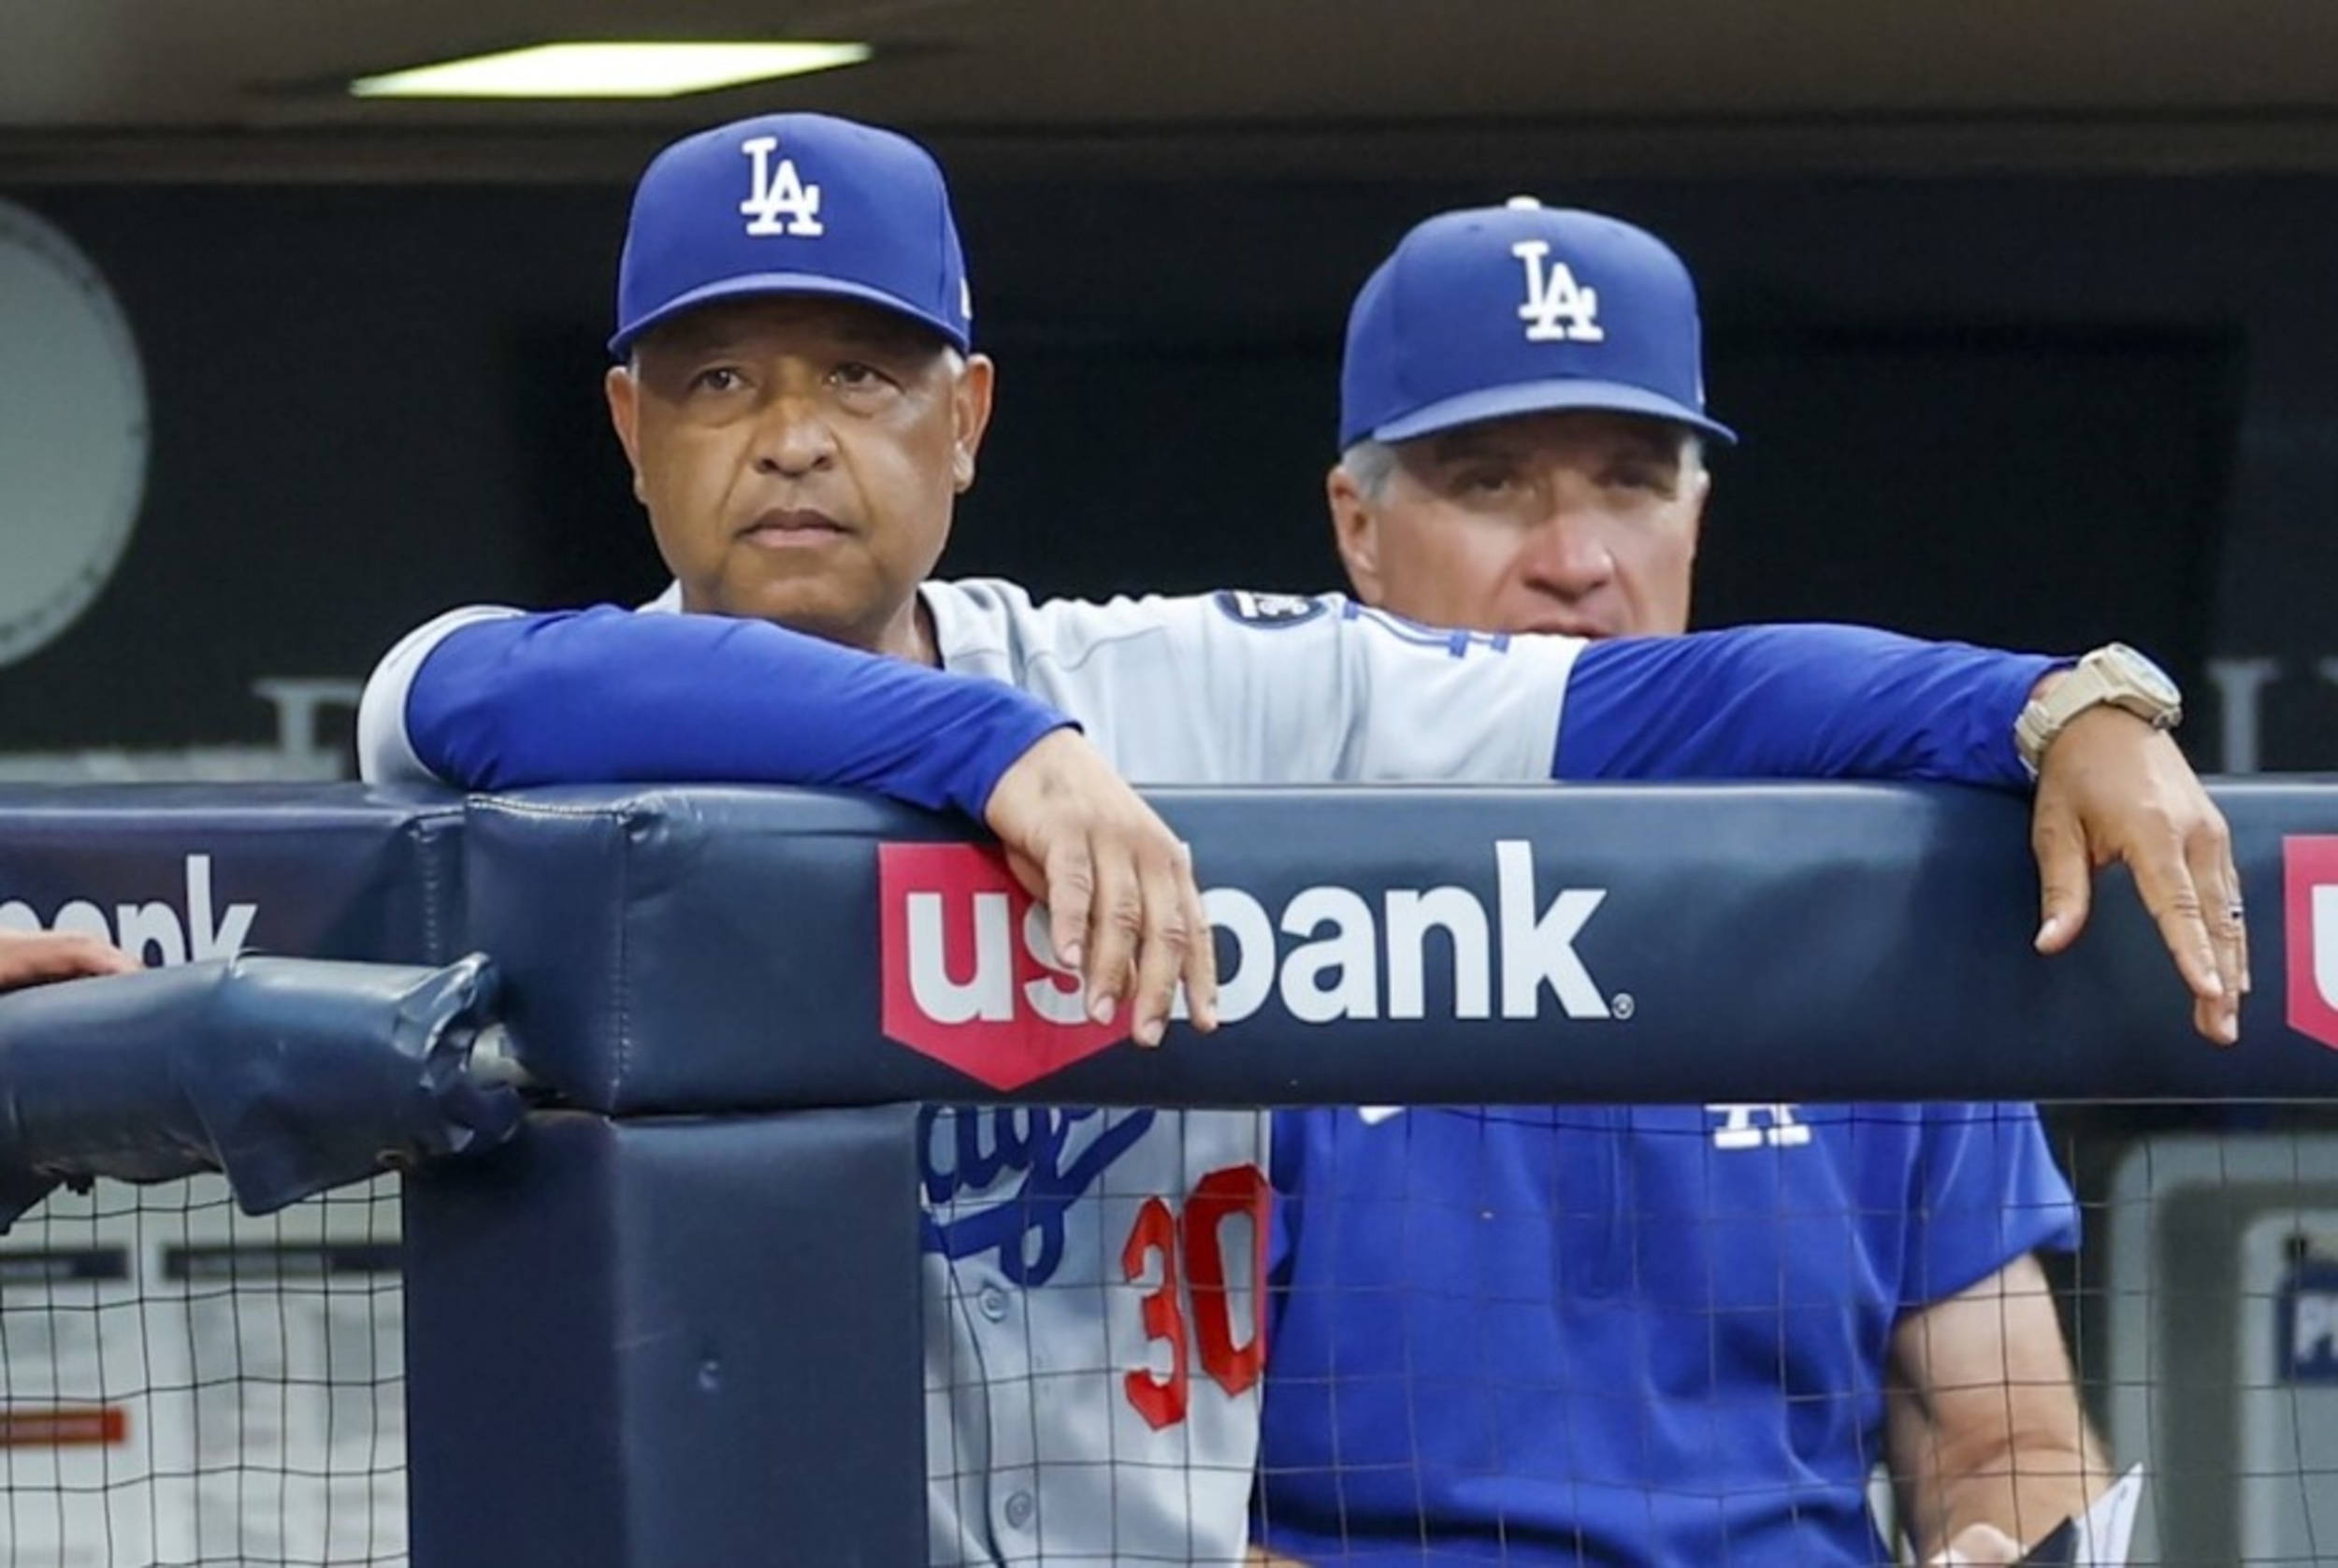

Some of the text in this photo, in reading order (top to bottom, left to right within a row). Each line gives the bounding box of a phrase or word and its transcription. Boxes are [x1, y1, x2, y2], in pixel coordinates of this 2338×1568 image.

[740, 136, 824, 236] LA
[1511, 239, 1605, 341] LA
[1121, 1162, 1270, 1431] 30
